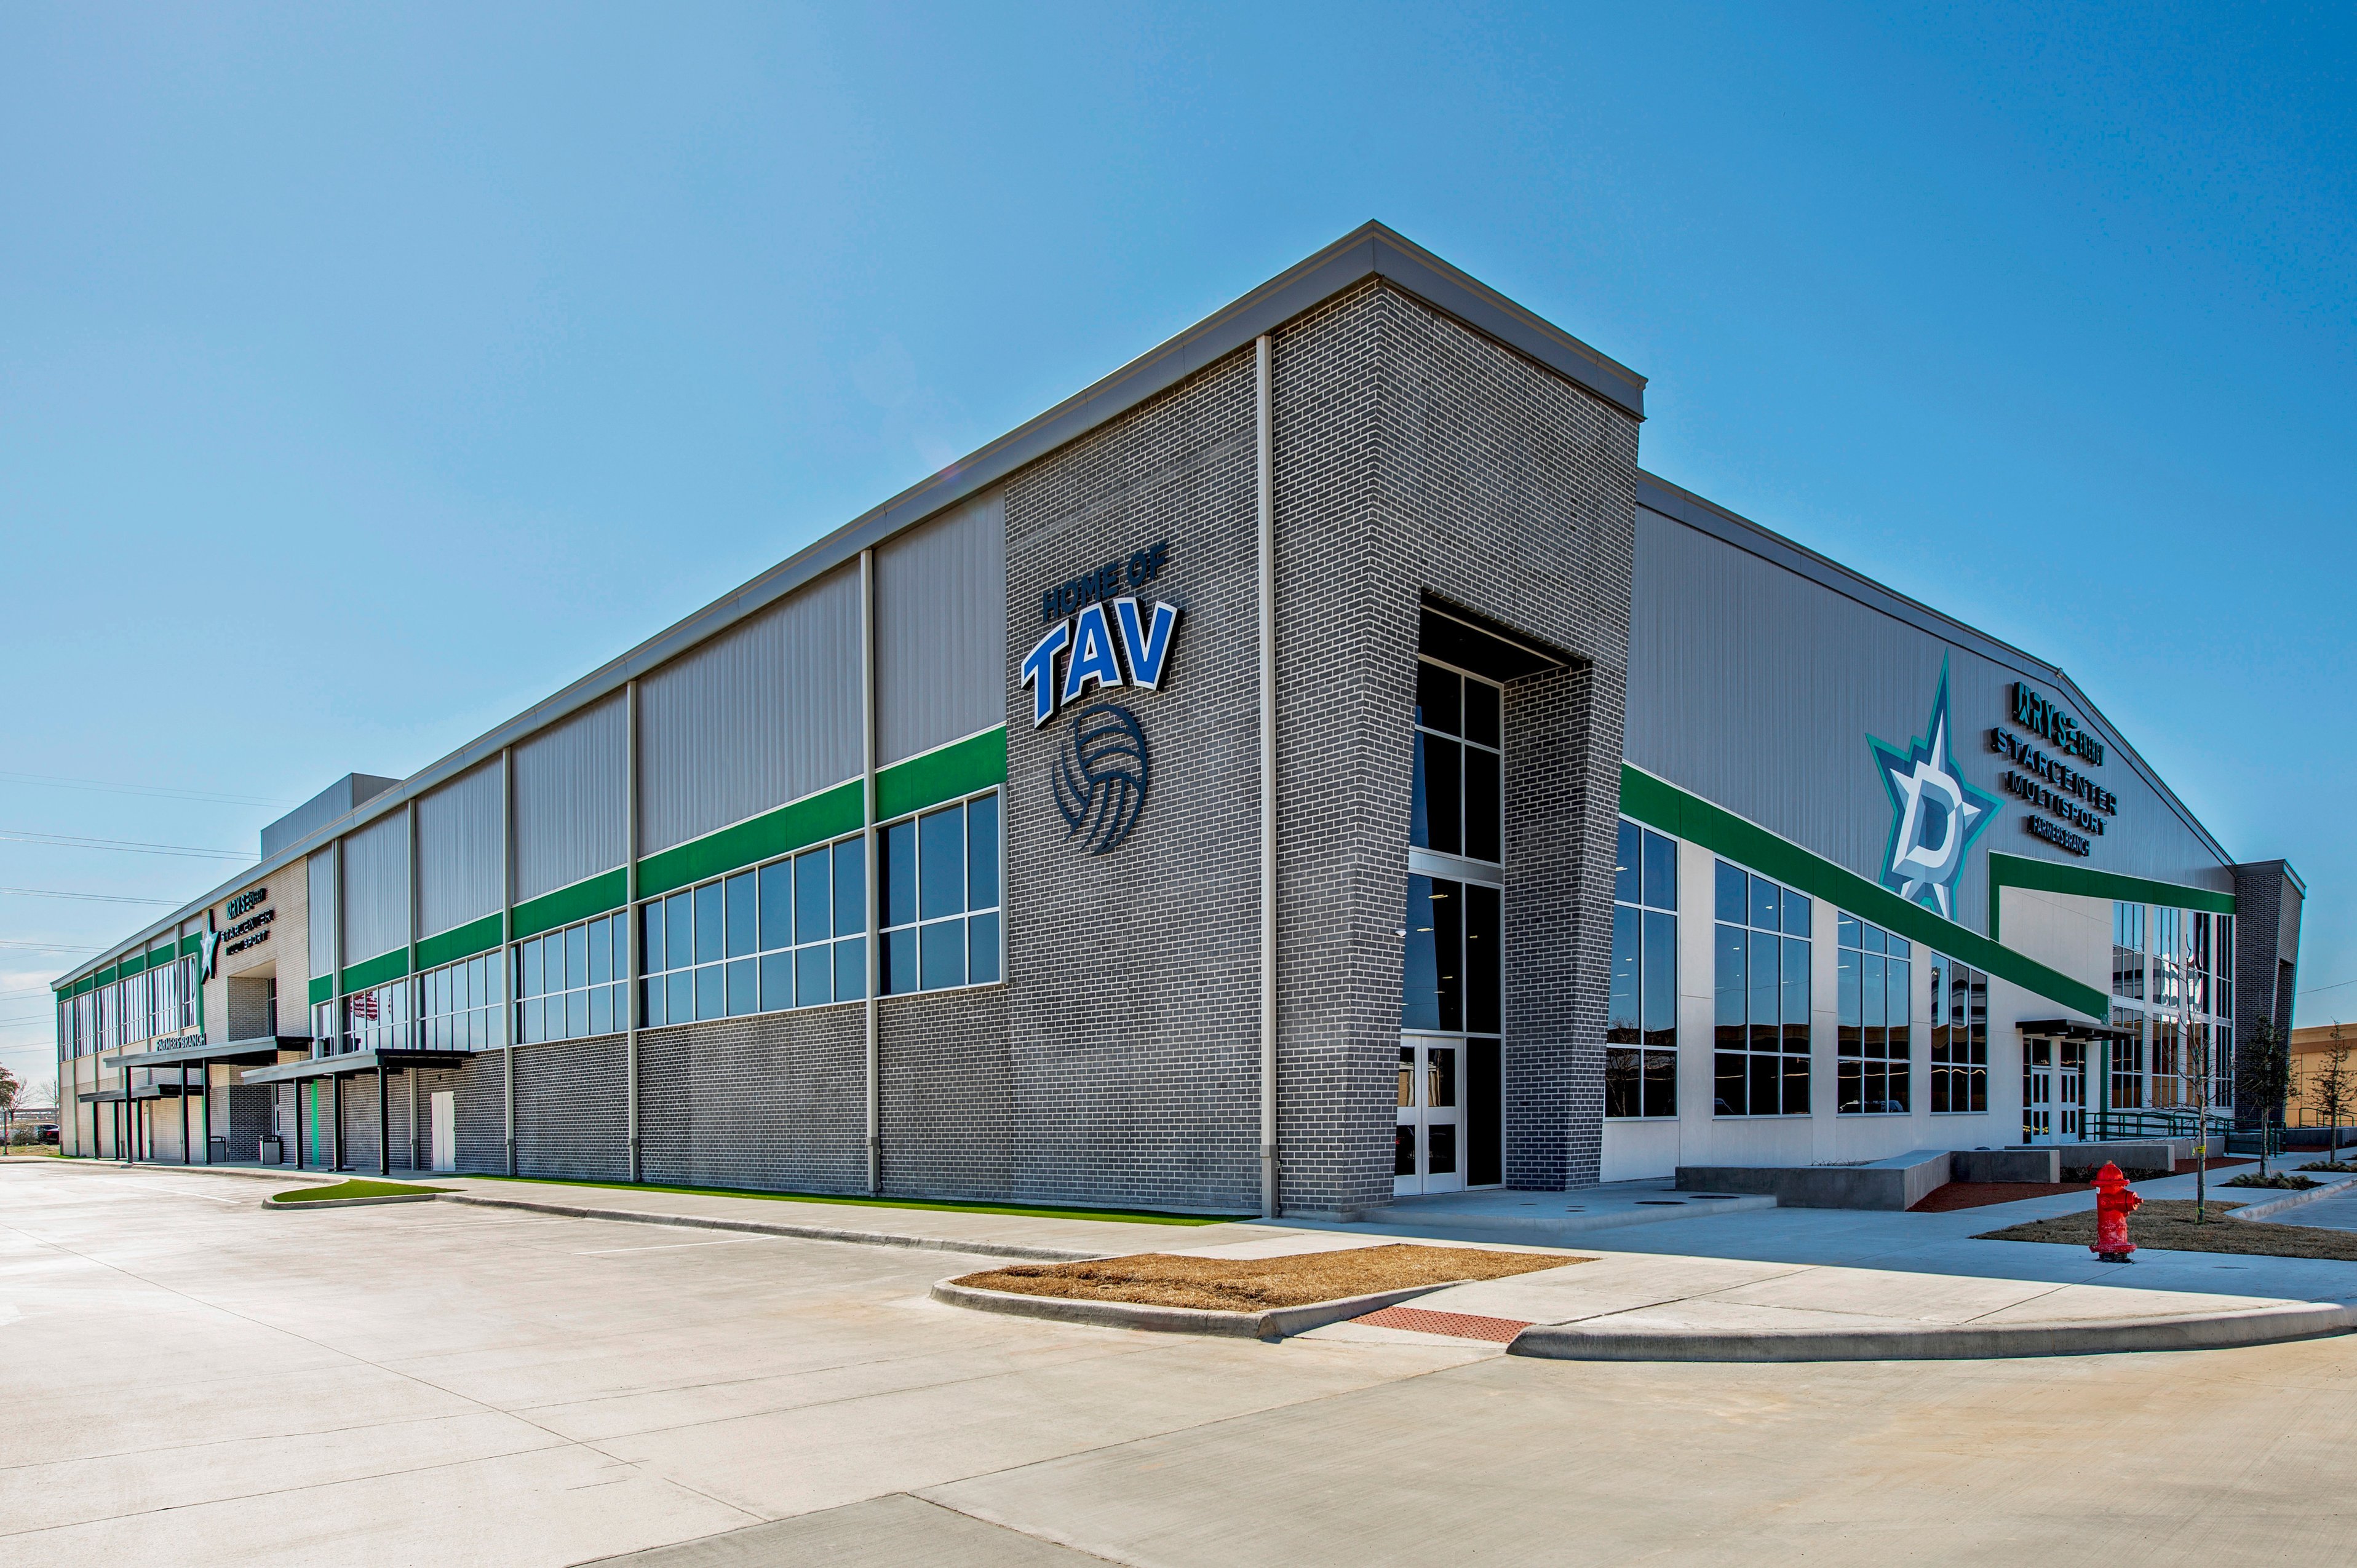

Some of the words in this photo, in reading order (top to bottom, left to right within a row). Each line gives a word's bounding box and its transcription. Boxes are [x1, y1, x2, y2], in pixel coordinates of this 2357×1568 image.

[1043, 562, 1119, 623] HOME
[1127, 542, 1168, 587] OF
[1021, 596, 1182, 730] TAV
[1991, 727, 2118, 816] STARCENTER
[2006, 770, 2107, 836] MULTISPORT
[2028, 815, 2064, 846] FARMERS
[2064, 830, 2091, 857] BRANCH
[225, 930, 269, 956] MULSPORT
[157, 1037, 181, 1051] FARMERS
[181, 1033, 207, 1048] BRANCH
